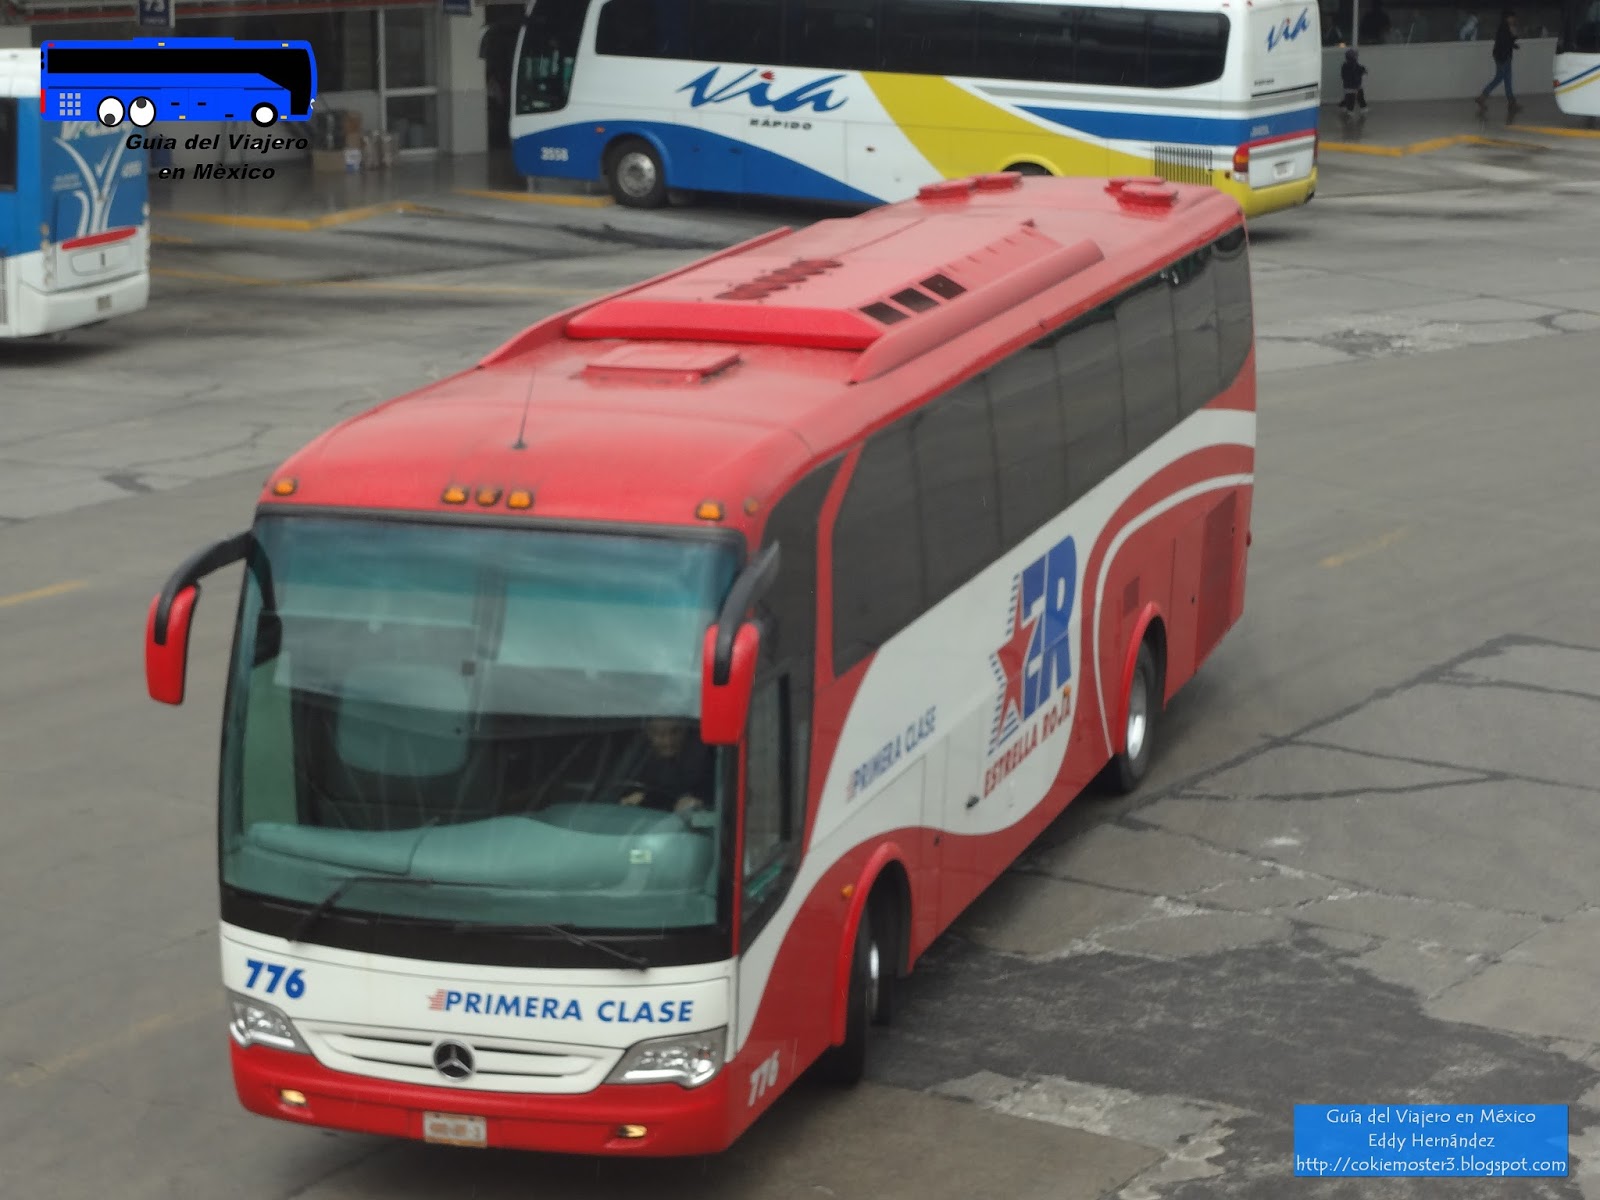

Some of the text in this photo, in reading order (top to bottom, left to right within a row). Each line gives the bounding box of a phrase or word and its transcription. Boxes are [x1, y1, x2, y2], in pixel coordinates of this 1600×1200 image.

[1267, 7, 1309, 52] Via
[676, 66, 848, 112] Via
[852, 705, 937, 793] PRIMERA CLASE
[984, 693, 1071, 799] ESTRELLA ROJA
[244, 958, 306, 999] 776
[445, 990, 695, 1023] PRIMERA CLASE
[747, 1049, 780, 1107] 776
